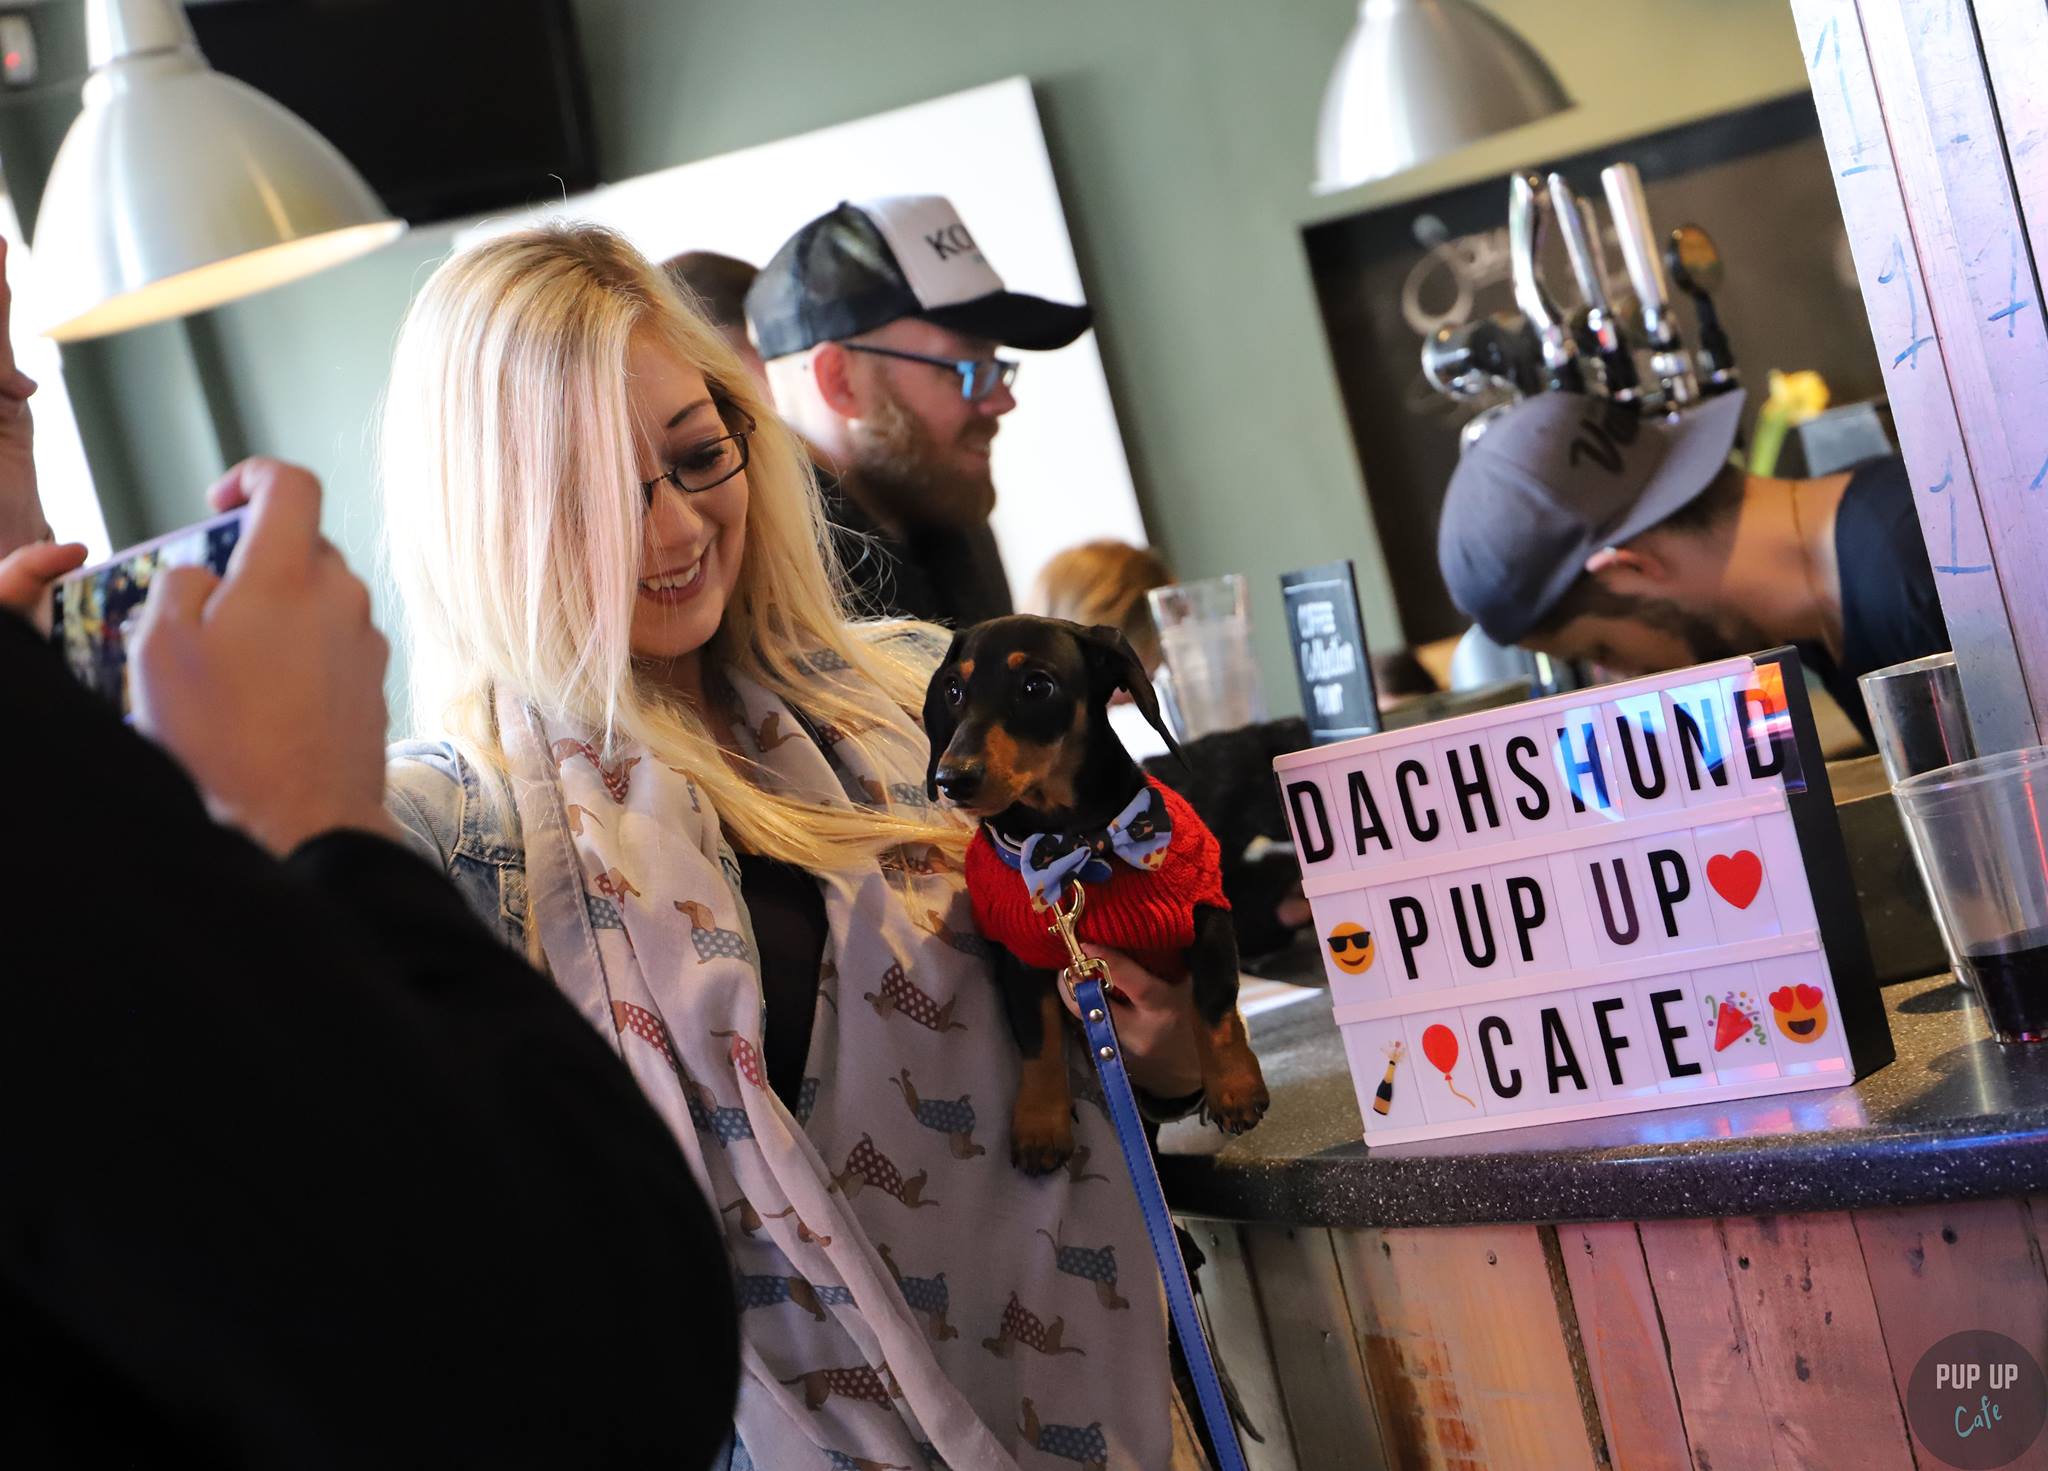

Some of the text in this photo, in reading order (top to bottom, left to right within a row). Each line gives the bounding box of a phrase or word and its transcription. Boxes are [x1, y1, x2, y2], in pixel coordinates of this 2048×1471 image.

[1287, 688, 1786, 864] DACHSHUND
[1389, 848, 1690, 980] PUP UP
[1477, 989, 1701, 1099] CAFE
